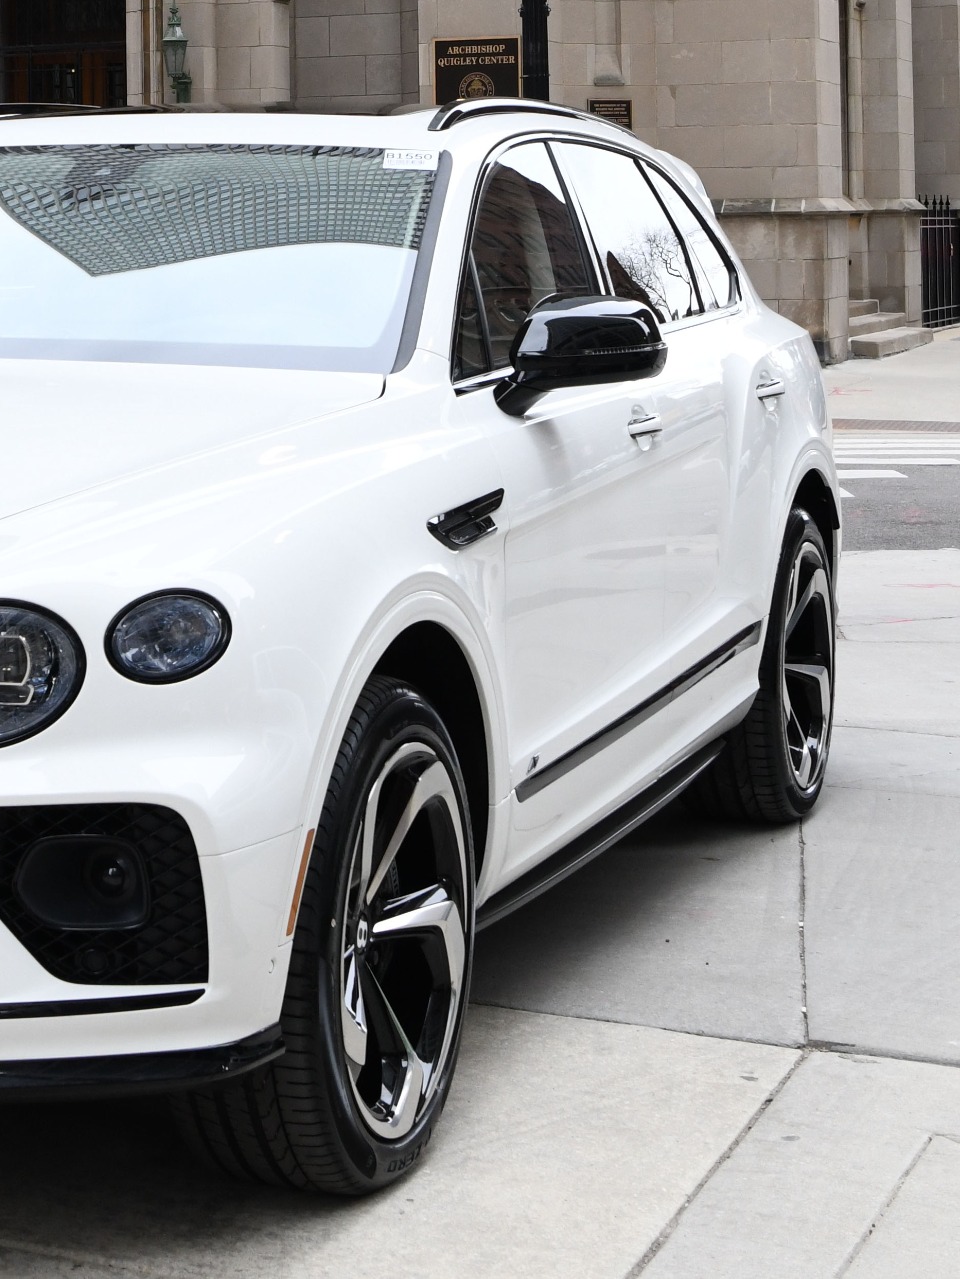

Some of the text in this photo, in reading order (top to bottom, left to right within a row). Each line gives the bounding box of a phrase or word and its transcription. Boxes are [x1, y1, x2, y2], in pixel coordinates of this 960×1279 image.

[447, 45, 505, 55] ARCHBISHOP
[438, 56, 515, 67] QUIGLEY CENTER
[356, 919, 368, 949] B
